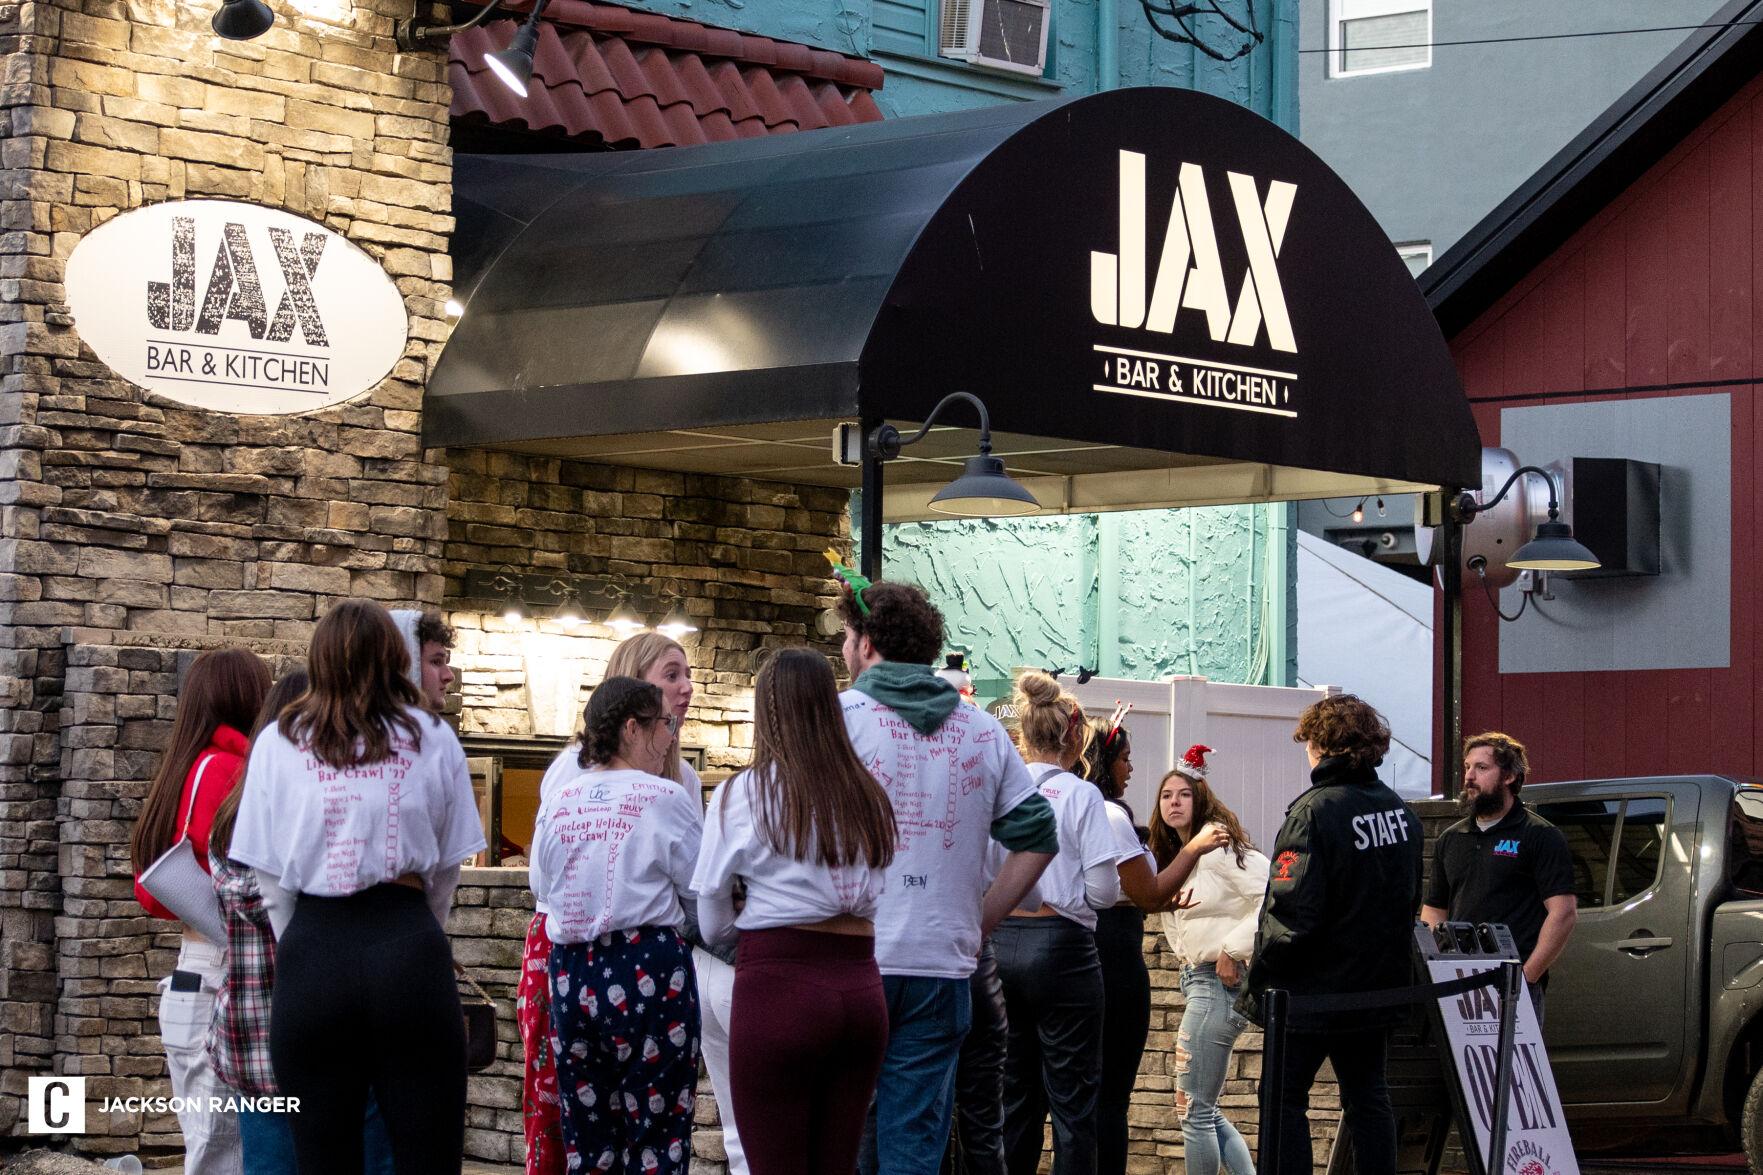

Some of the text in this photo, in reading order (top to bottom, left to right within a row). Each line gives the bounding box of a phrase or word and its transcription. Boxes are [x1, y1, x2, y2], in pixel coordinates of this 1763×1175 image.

[1090, 149, 1298, 354] JAX
[147, 216, 330, 347] JAX
[147, 346, 329, 387] BAR & KITCHEN
[1116, 357, 1277, 406] BAR & KITCHEN
[879, 718, 912, 729] LineLe
[941, 722, 966, 738] liday
[891, 730, 909, 740] Bar
[913, 732, 943, 745] Crawl
[318, 770, 338, 782] Bar
[344, 766, 384, 780] Crawl
[619, 804, 643, 814] TRULY
[554, 817, 634, 834] LineLeap Holiday
[1352, 808, 1409, 851] STAFF
[560, 834, 576, 845] Bar
[579, 829, 608, 842] Crawl
[1494, 839, 1520, 854] JAX
[903, 874, 928, 888] BEN
[1455, 968, 1518, 1021] JA
[1470, 1024, 1483, 1033] BAR
[1506, 1139, 1552, 1172] FIREBALL
